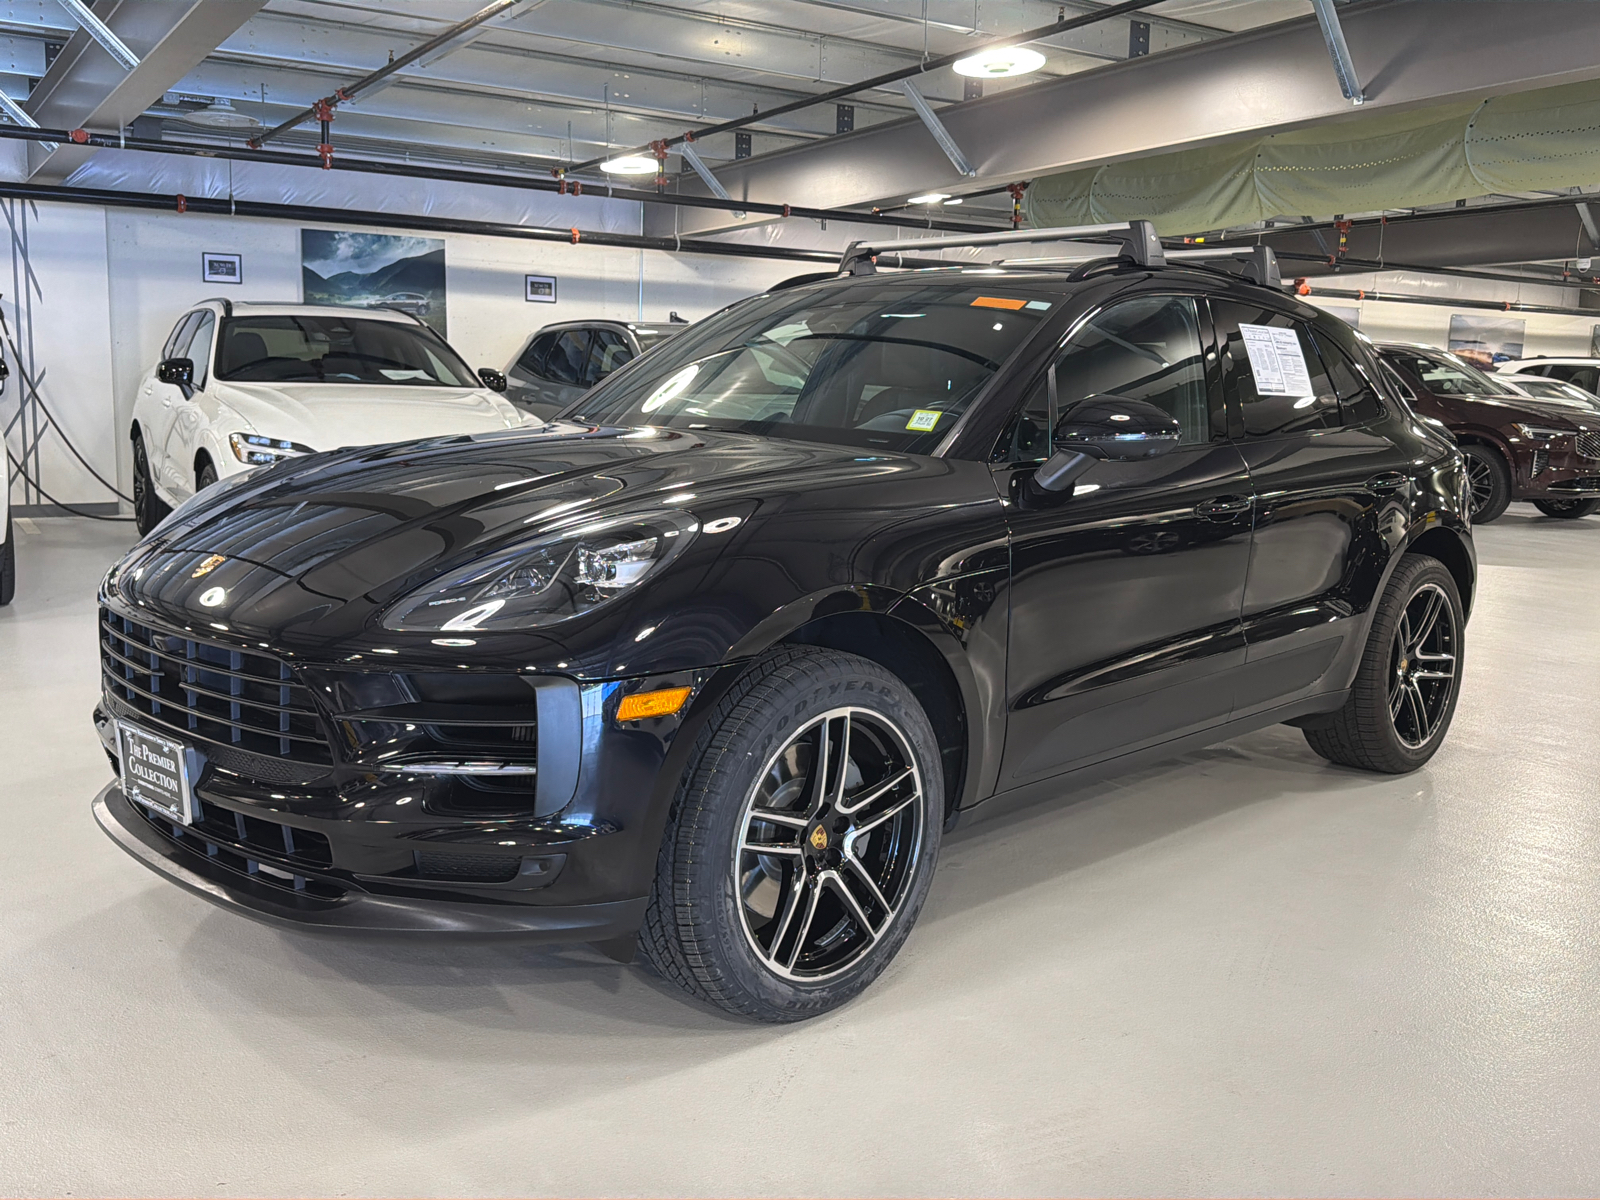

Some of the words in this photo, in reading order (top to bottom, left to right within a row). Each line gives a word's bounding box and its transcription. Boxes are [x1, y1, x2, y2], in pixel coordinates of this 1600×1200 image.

[127, 737, 143, 760] THE
[142, 744, 177, 773] PREMIER
[128, 755, 178, 793] COLLECTION
